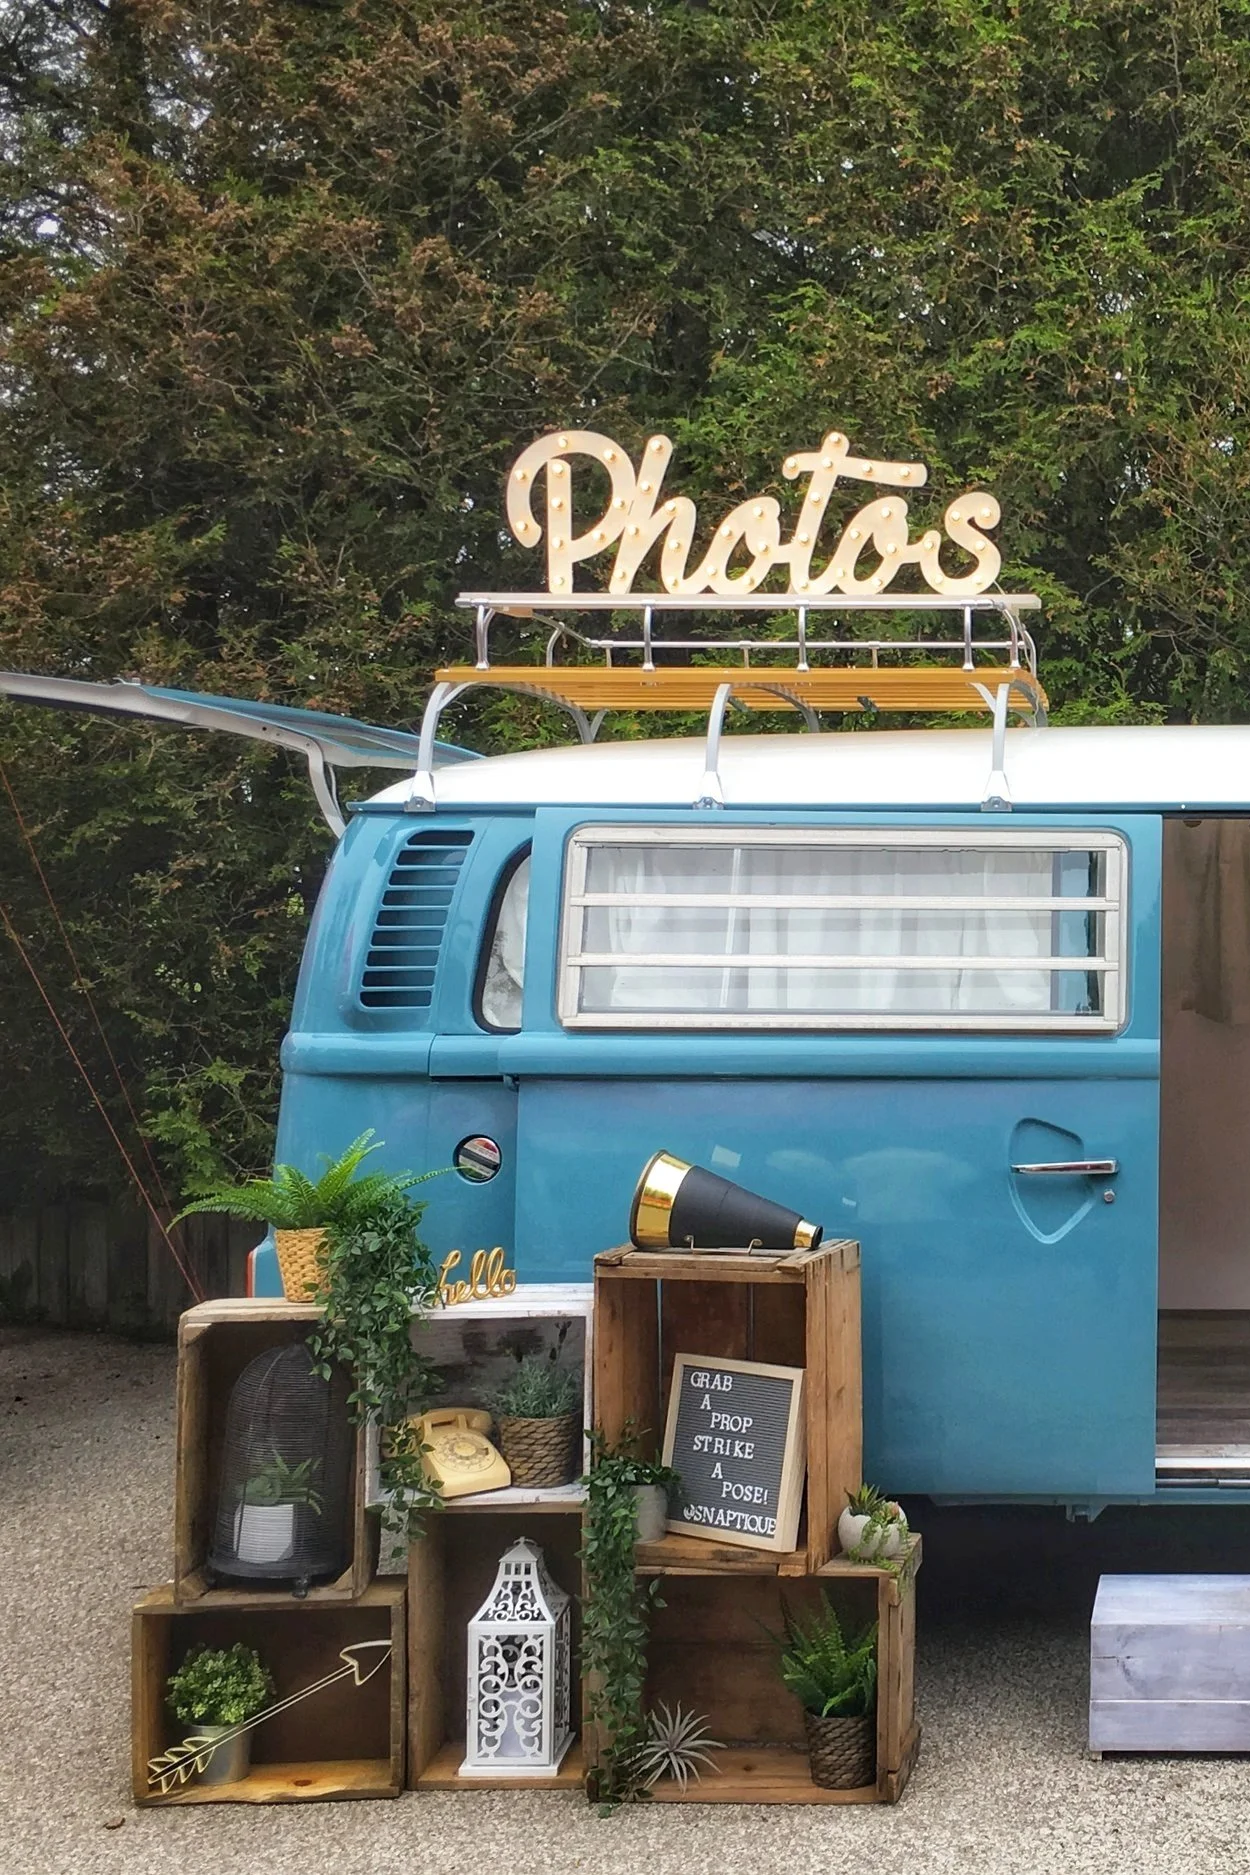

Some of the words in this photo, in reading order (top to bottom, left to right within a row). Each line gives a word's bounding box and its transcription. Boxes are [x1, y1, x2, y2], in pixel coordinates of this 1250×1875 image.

[506, 429, 1001, 596] Photos
[432, 1247, 517, 1306] hello
[690, 1371, 733, 1392] GRAB
[700, 1393, 712, 1410] A
[710, 1412, 753, 1434] PROP
[692, 1434, 755, 1459] STRIKE
[711, 1462, 723, 1479] A
[720, 1481, 768, 1505] POSE!
[683, 1503, 777, 1535] @SNAPTIQUE
